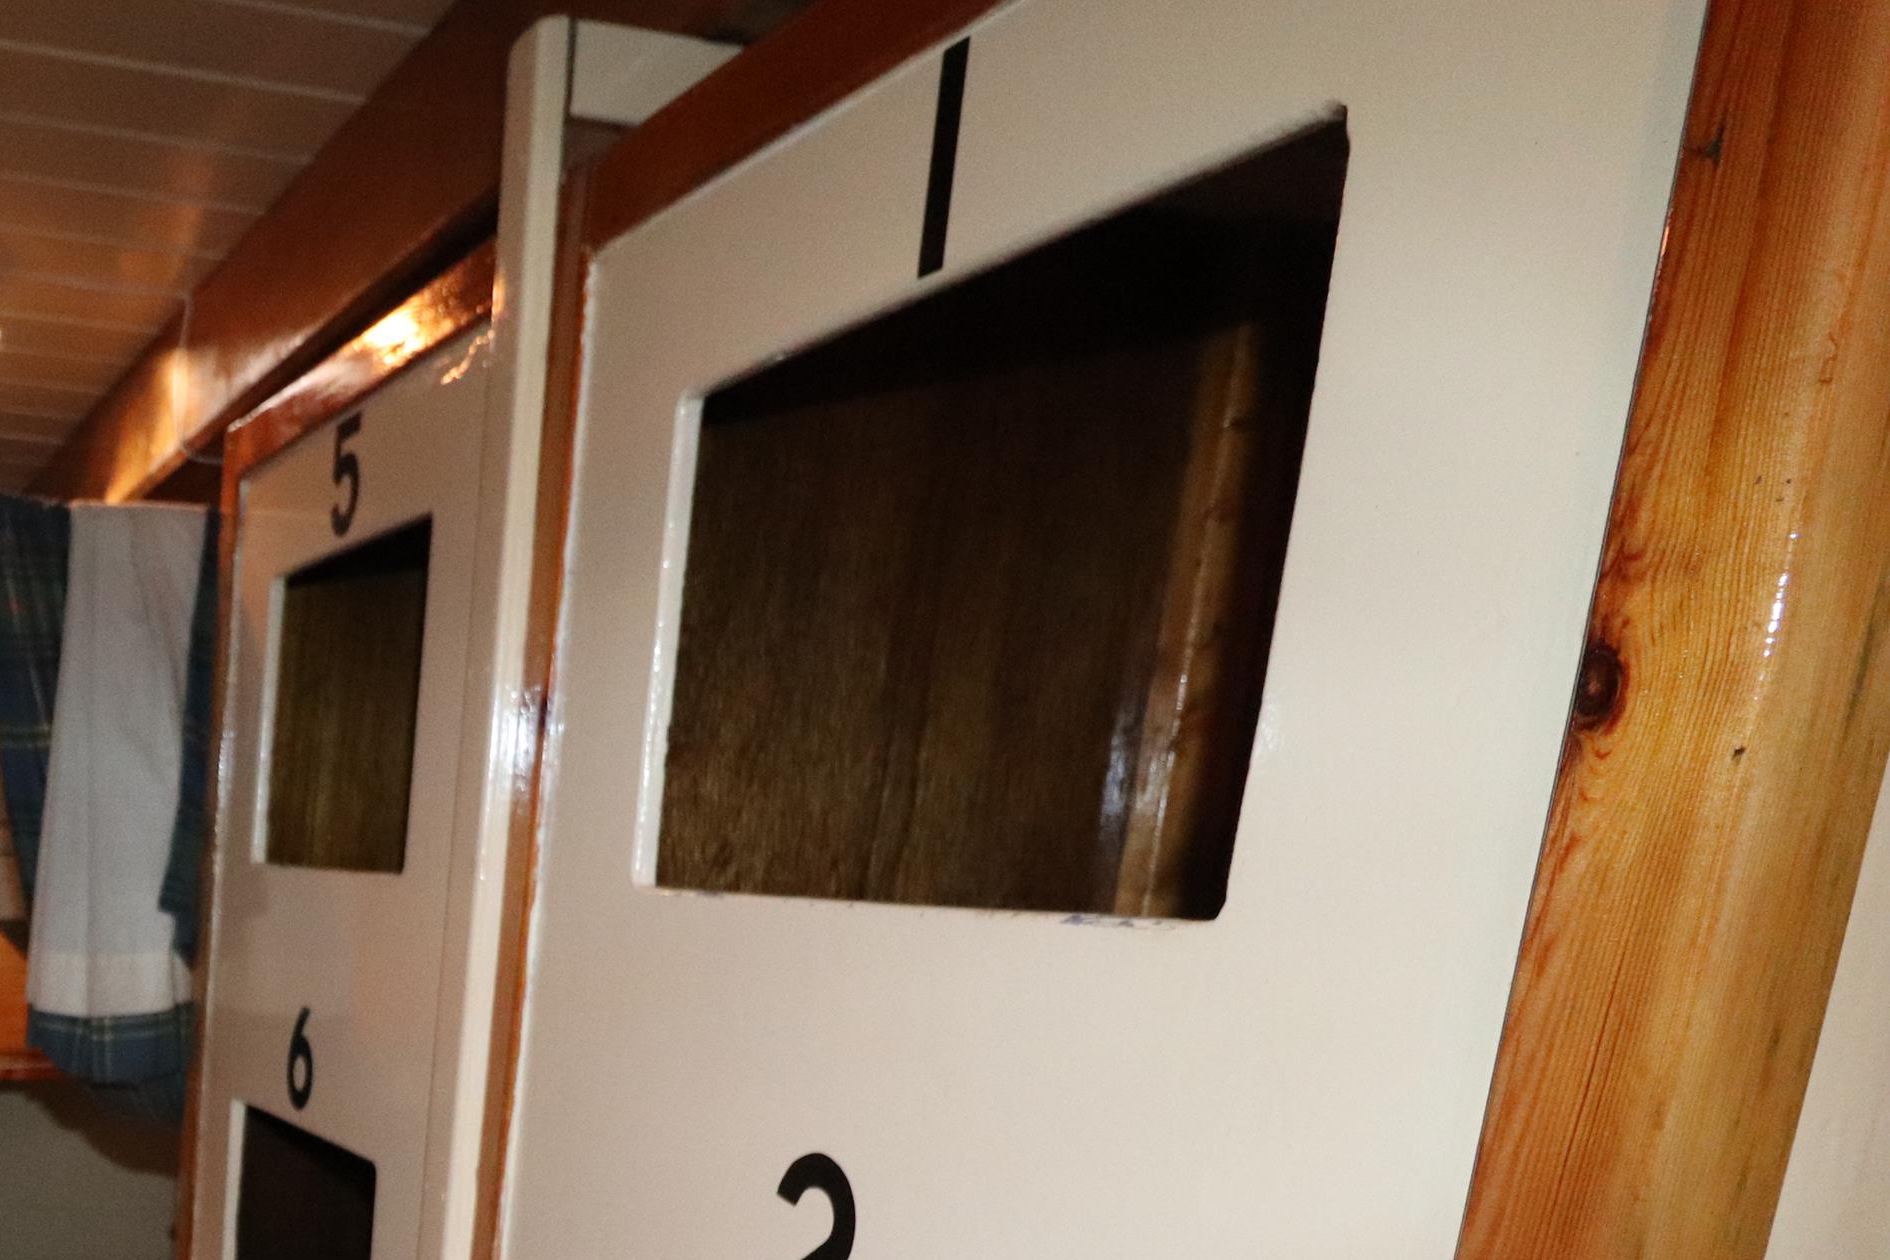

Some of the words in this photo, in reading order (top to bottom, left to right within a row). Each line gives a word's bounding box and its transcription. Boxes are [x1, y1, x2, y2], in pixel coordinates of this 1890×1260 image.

[918, 36, 970, 278] 1
[331, 412, 363, 537] 5
[287, 1008, 313, 1107] 6
